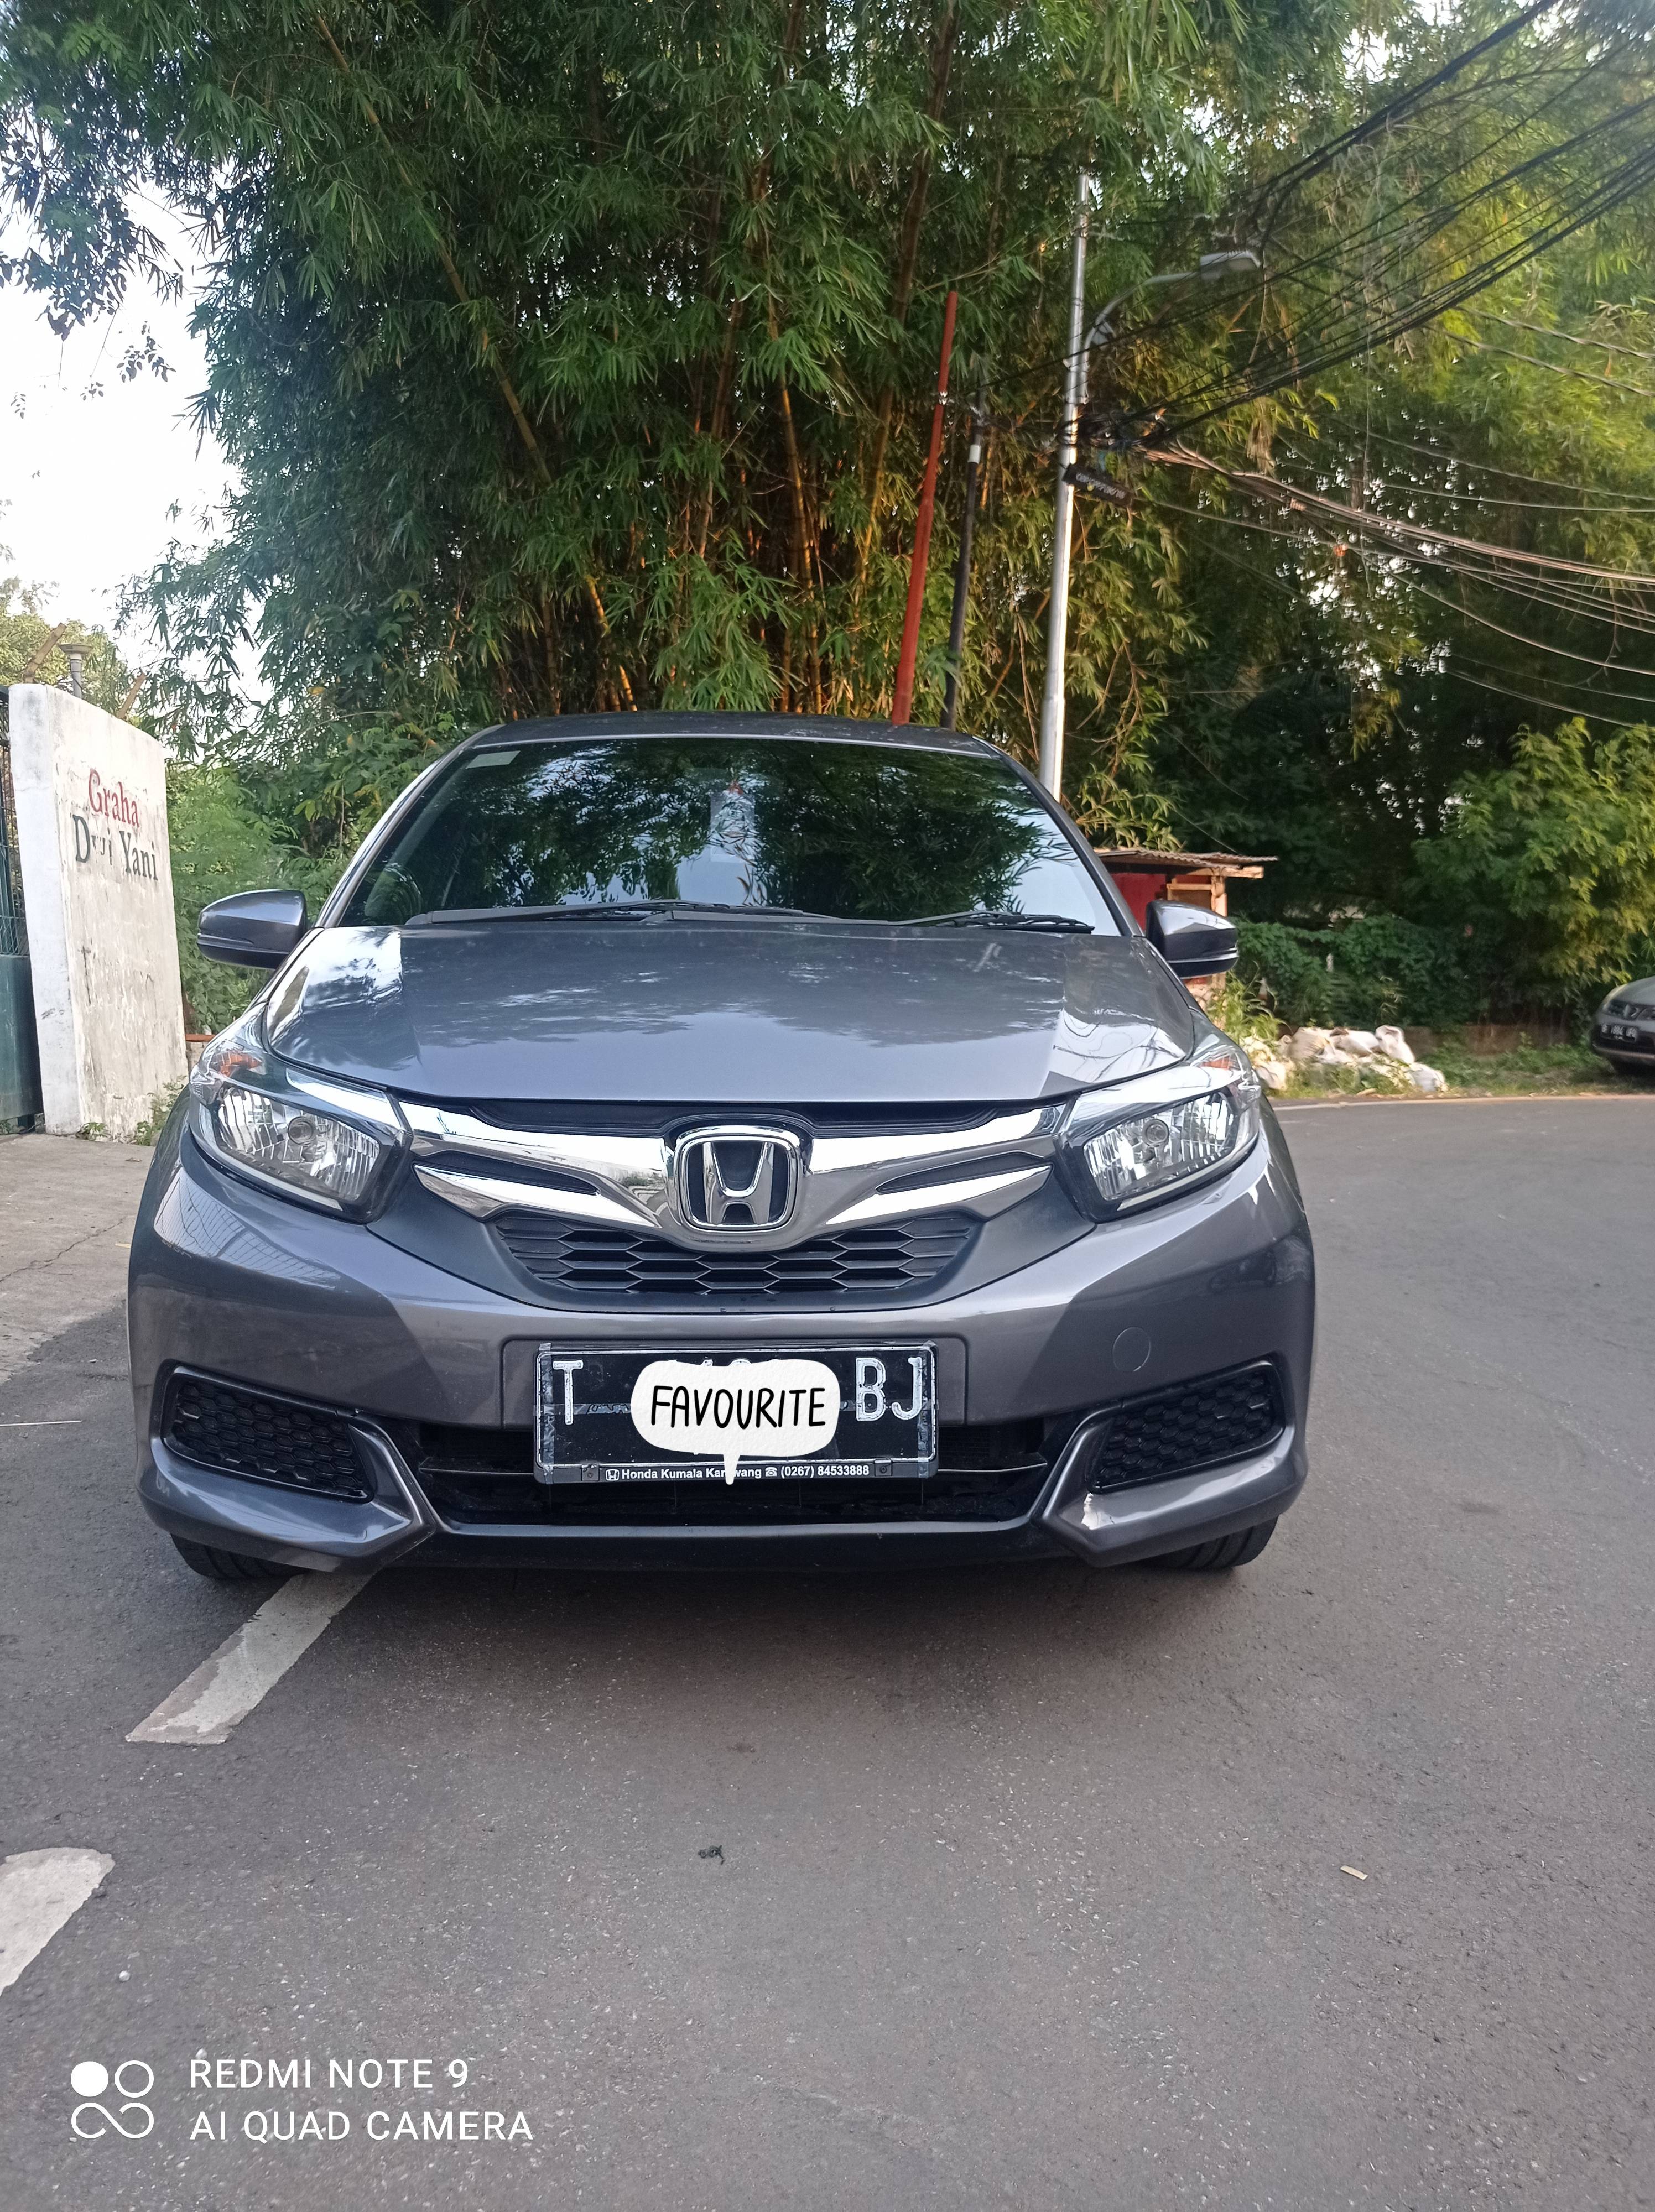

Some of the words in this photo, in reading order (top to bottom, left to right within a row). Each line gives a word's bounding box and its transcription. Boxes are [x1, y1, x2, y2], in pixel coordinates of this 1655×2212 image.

[89, 768, 140, 828] Graha
[119, 831, 158, 881] Yani
[553, 1360, 584, 1425] T
[855, 1357, 923, 1421] BJ
[622, 1469, 658, 1479] Honda
[661, 1468, 702, 1479] Kumala
[706, 1468, 762, 1479] Karwang
[780, 1465, 815, 1479] (0267)
[818, 1465, 870, 1476] 84533888
